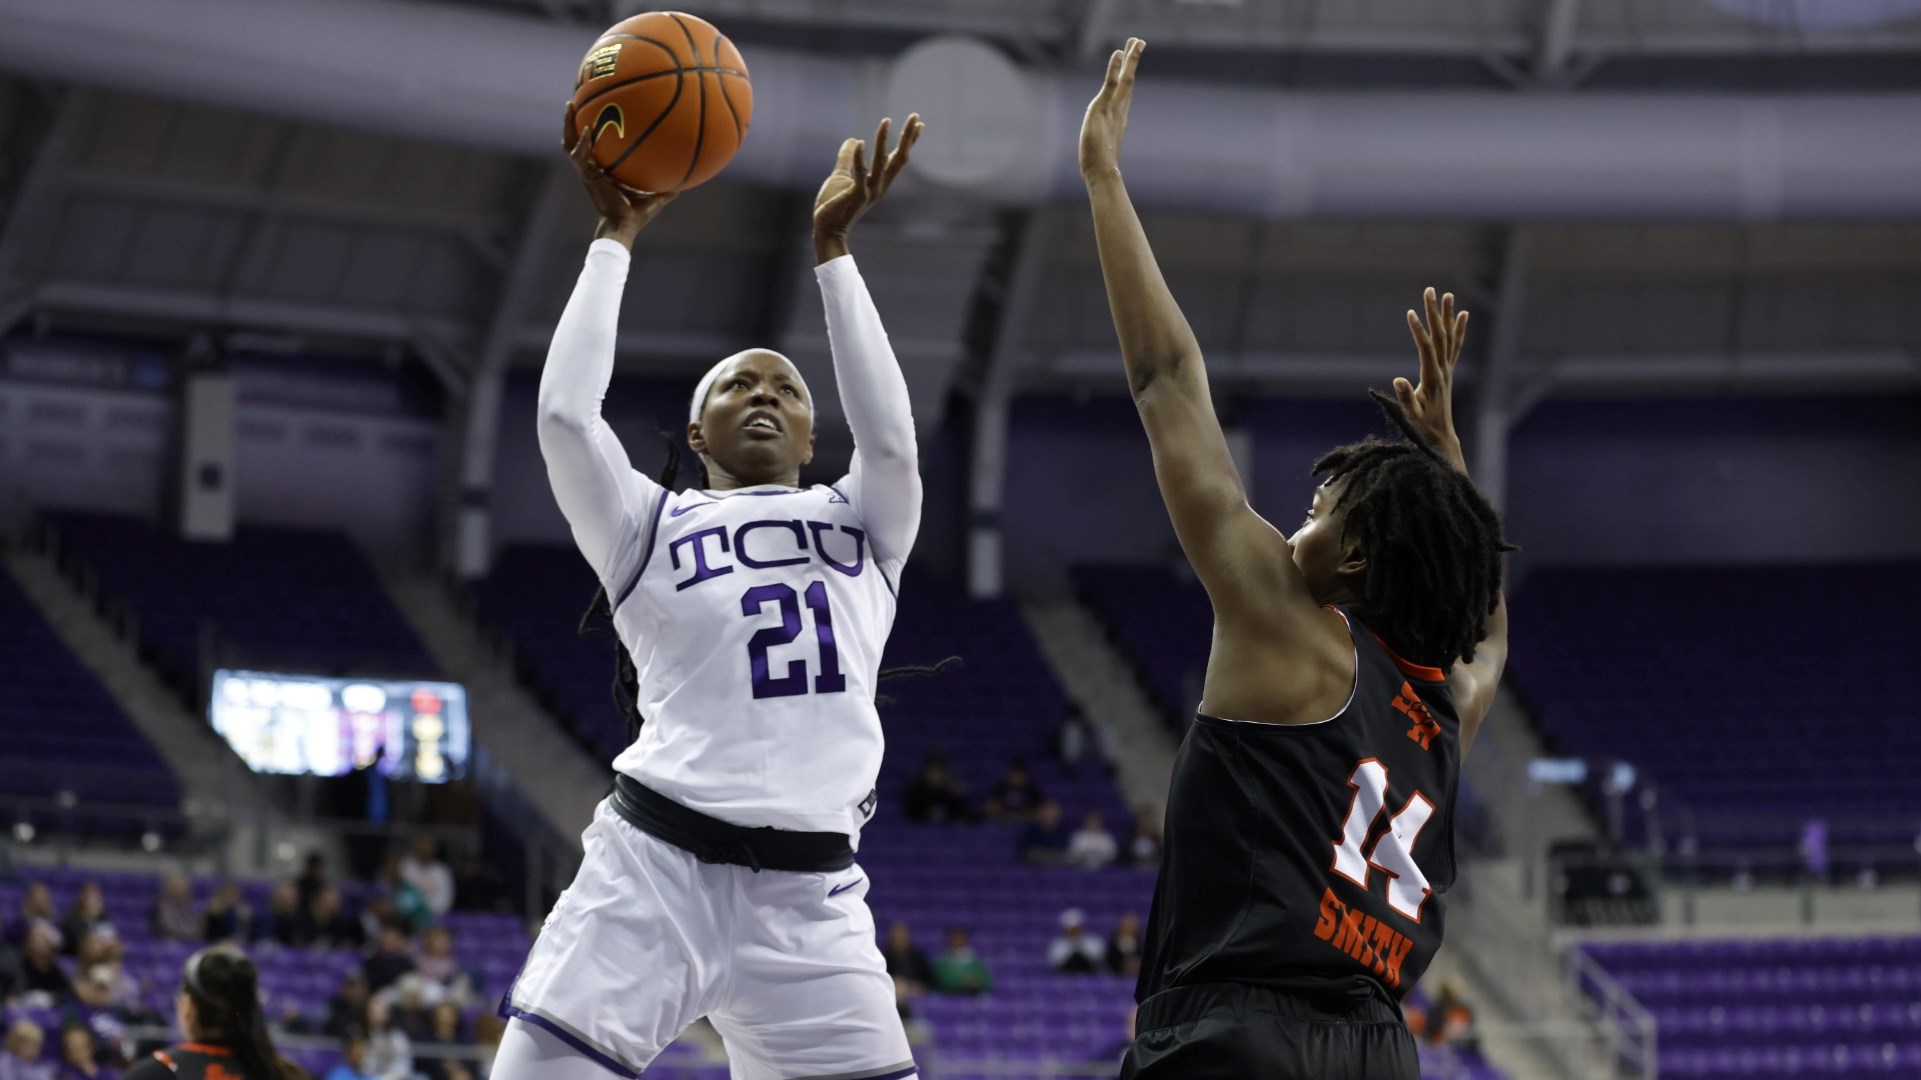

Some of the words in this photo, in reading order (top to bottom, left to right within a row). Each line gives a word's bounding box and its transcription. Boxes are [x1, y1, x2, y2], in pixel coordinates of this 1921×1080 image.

[669, 519, 865, 591] TCU
[740, 581, 846, 699] 21
[1330, 757, 1436, 924] 14
[1313, 887, 1413, 989] SMITH
